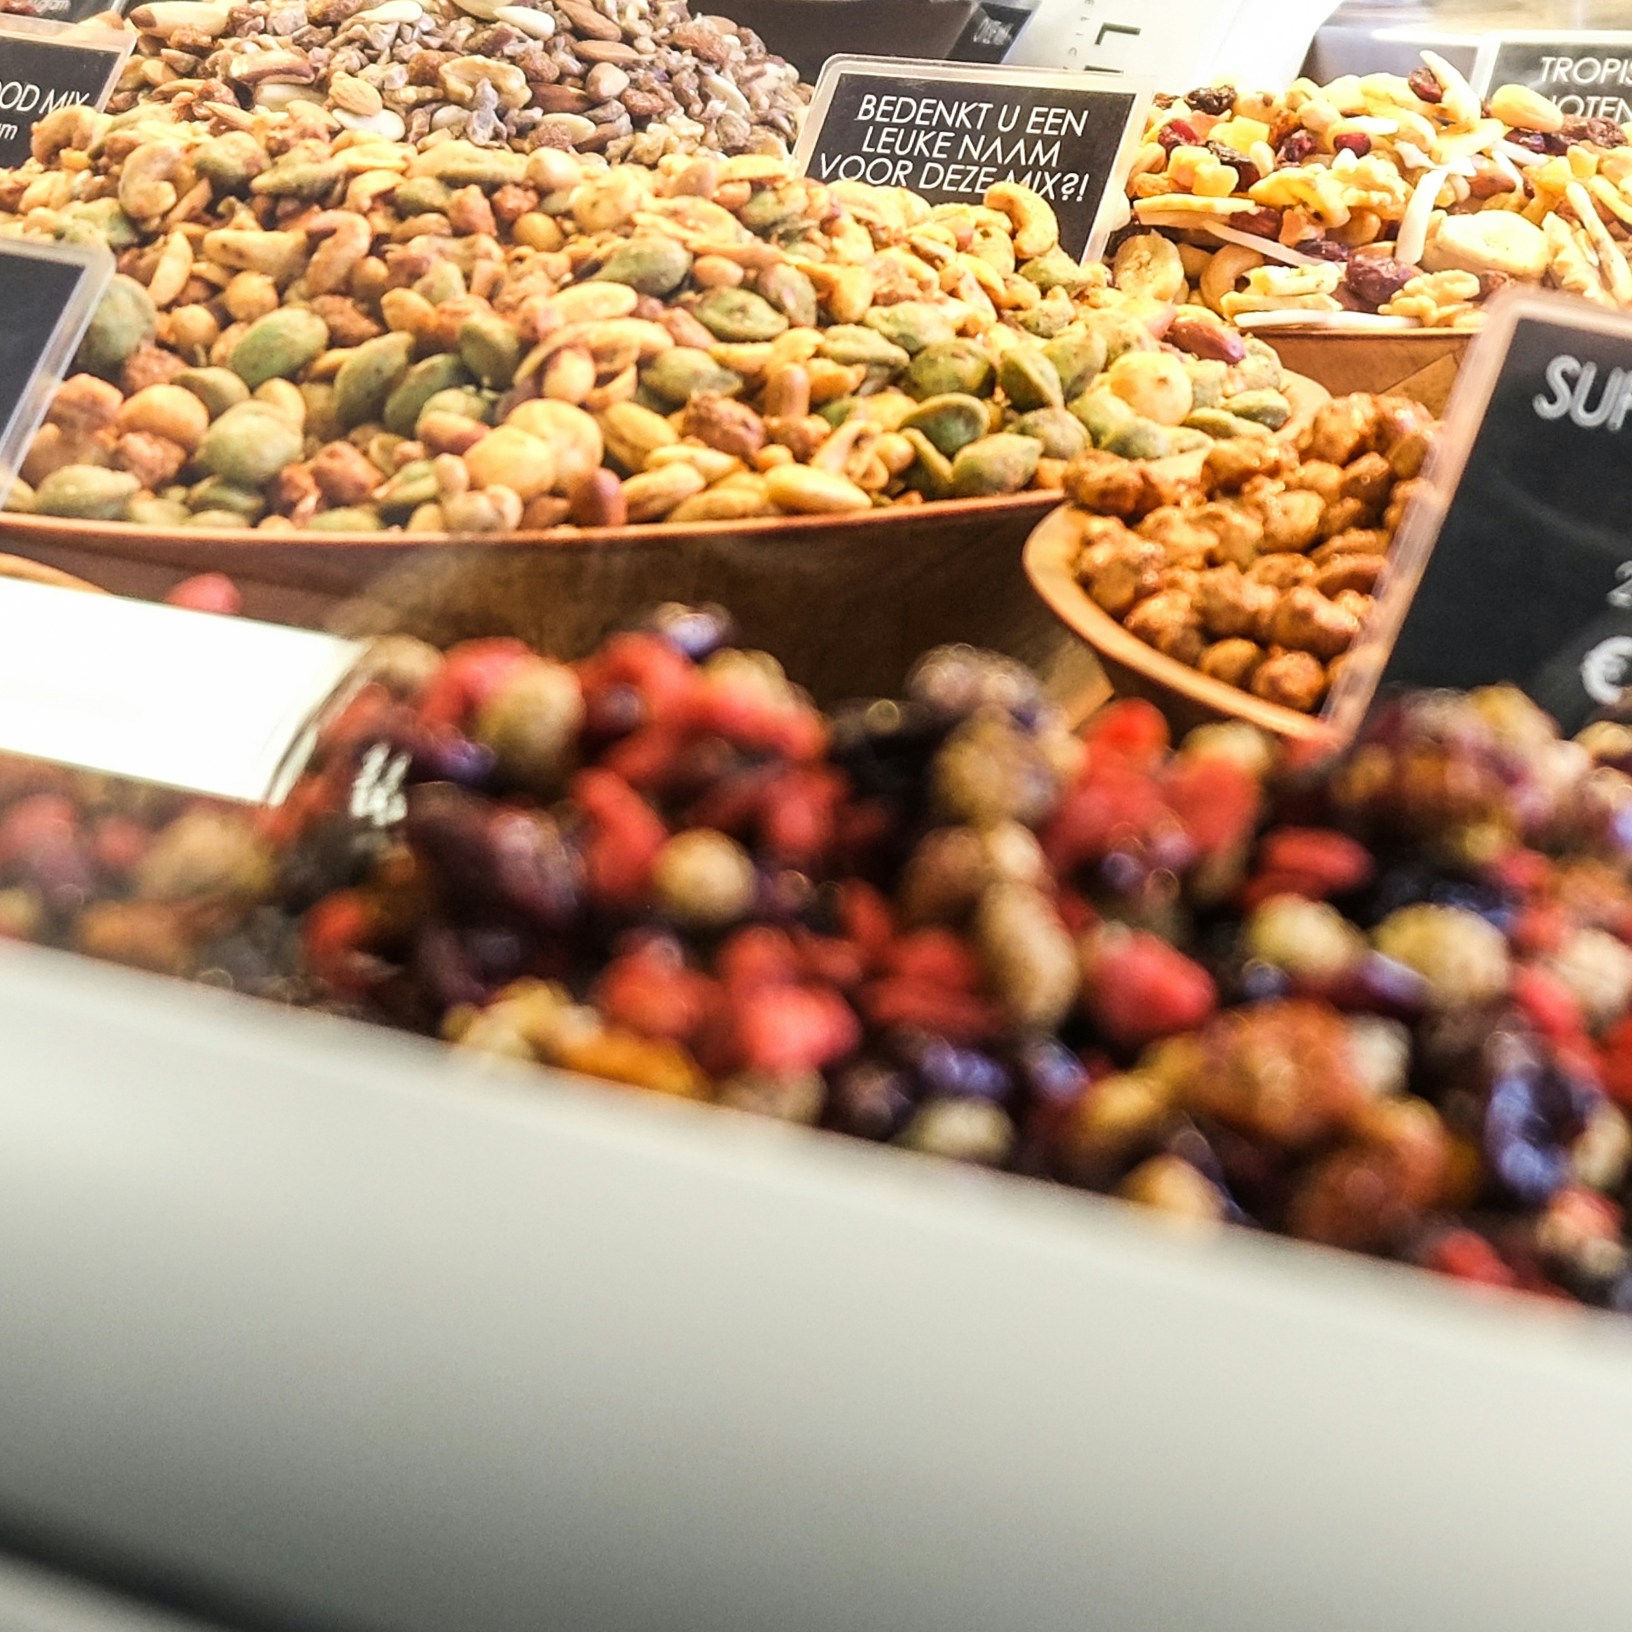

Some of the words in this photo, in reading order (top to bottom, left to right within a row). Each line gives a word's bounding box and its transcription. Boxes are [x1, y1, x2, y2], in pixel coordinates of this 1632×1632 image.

[855, 94, 994, 131] BEDENKT
[997, 104, 1021, 132] U
[1025, 106, 1090, 137] EEN
[862, 125, 956, 160] LEUKE
[957, 134, 1062, 168] NAAM
[819, 153, 914, 188] VOOR
[917, 162, 998, 195] DEZE
